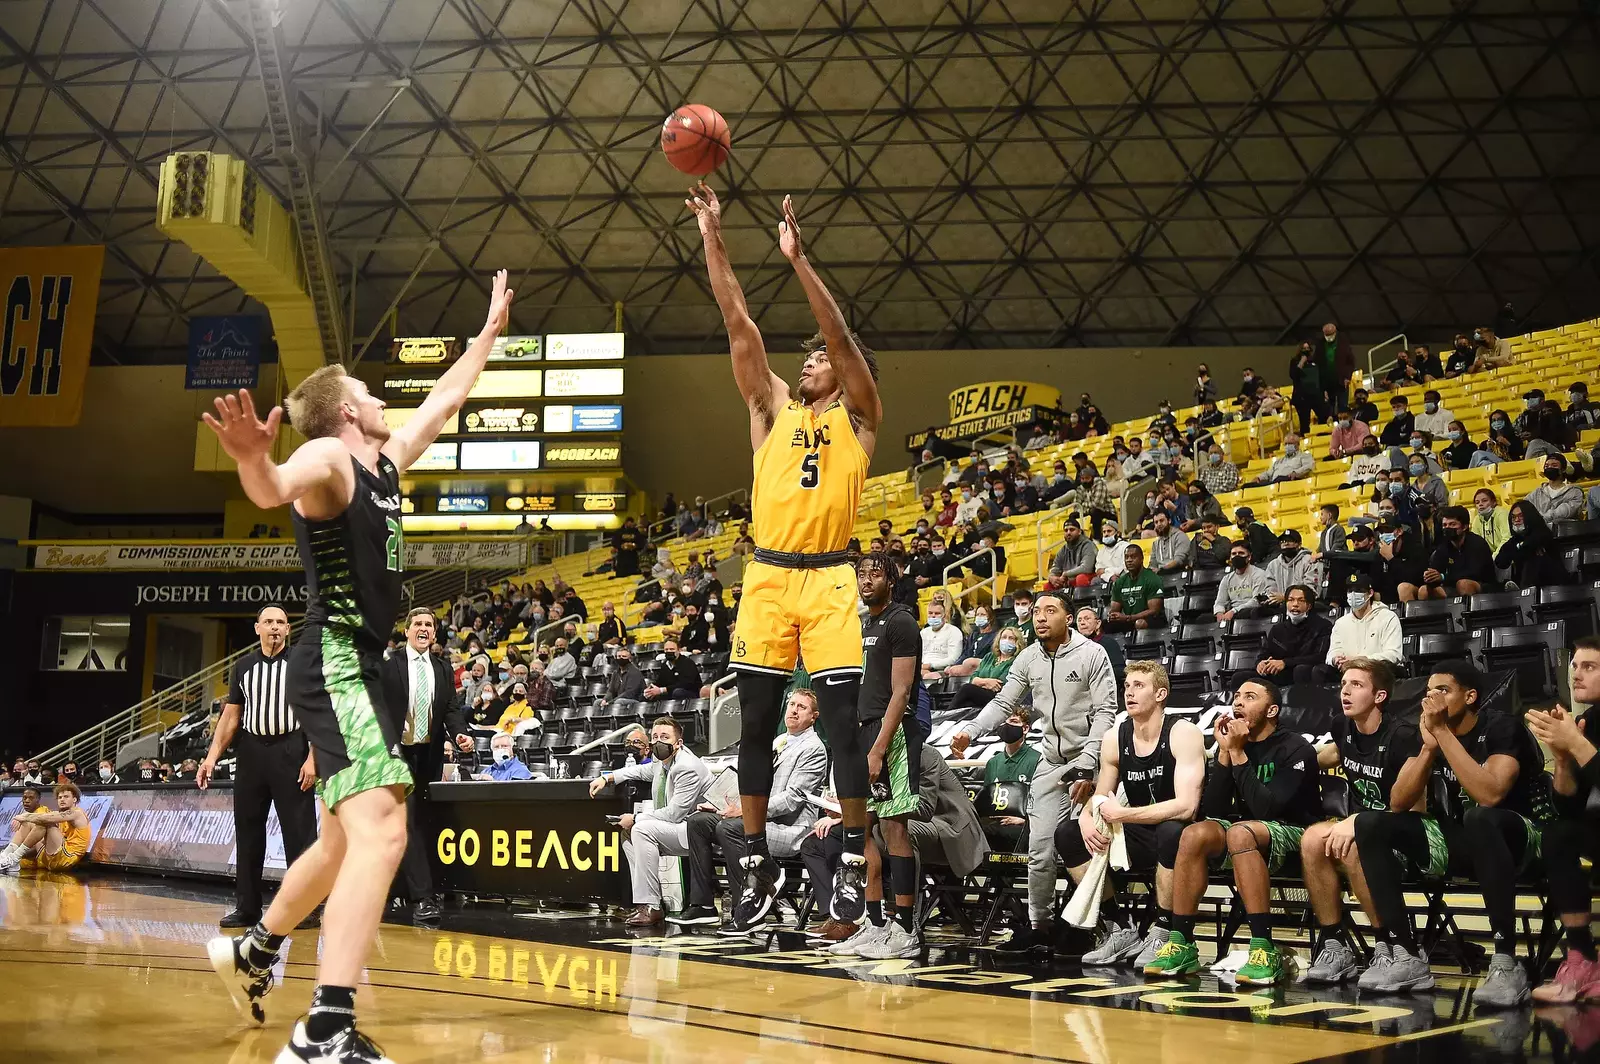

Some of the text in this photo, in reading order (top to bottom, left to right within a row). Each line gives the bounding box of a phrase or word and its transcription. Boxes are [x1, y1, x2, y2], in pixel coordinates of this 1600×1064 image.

[935, 426, 957, 441] EACH
[958, 420, 984, 437] STATE
[985, 408, 1032, 431] ATHLETICS
[800, 452, 820, 490] 5
[45, 547, 109, 567] Beach
[118, 547, 246, 559] COMMISSIONER'S
[250, 547, 279, 559] CUP
[135, 584, 310, 606] JOSEPH THOMAS
[1344, 756, 1361, 774] UTAH
[1127, 770, 1146, 781] UTAH
[437, 828, 620, 872] GO BEACH
[1018, 855, 1030, 864] STAT
